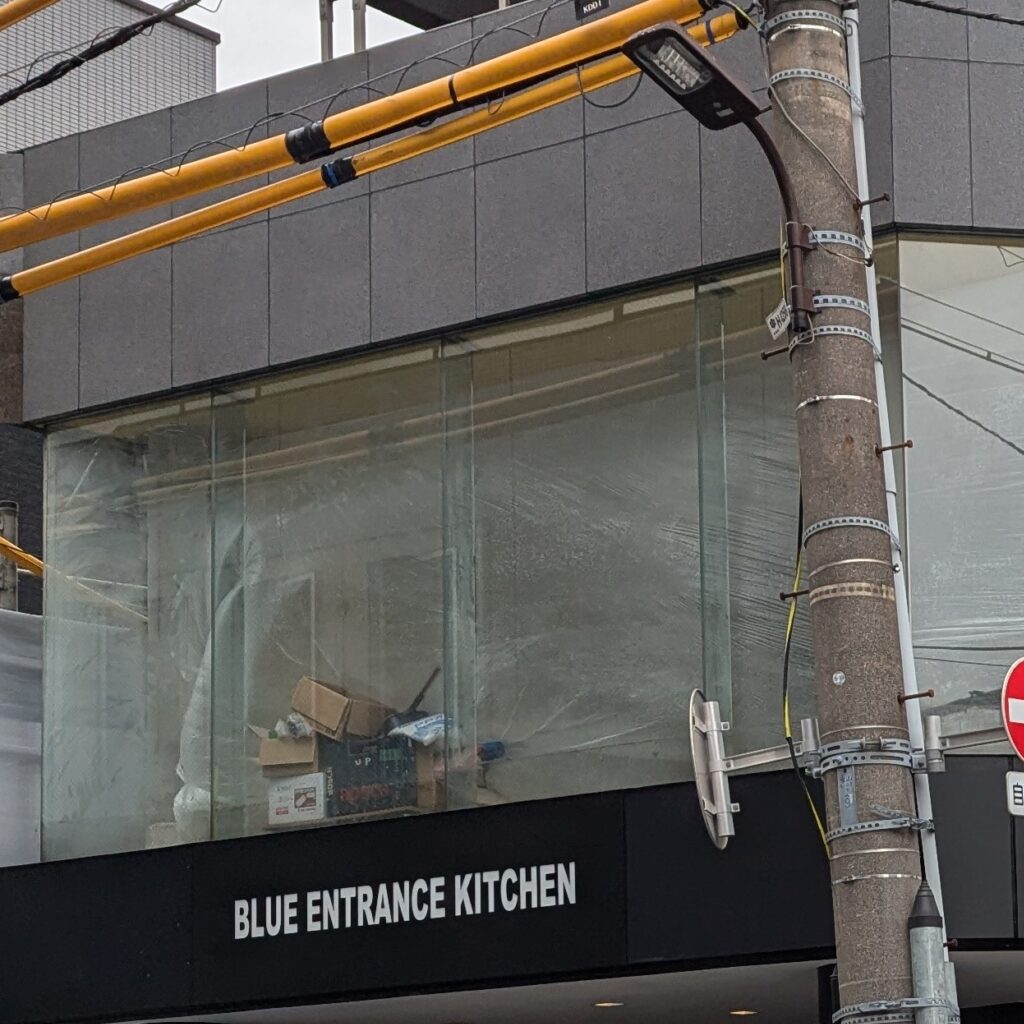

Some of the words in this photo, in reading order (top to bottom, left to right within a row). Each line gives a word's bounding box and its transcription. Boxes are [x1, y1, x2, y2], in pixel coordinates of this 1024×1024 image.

[583, 0, 601, 13] KDDI
[234, 893, 298, 939] BLUE
[307, 877, 446, 932] ENTRANCE
[454, 861, 577, 916] KITCHEN
